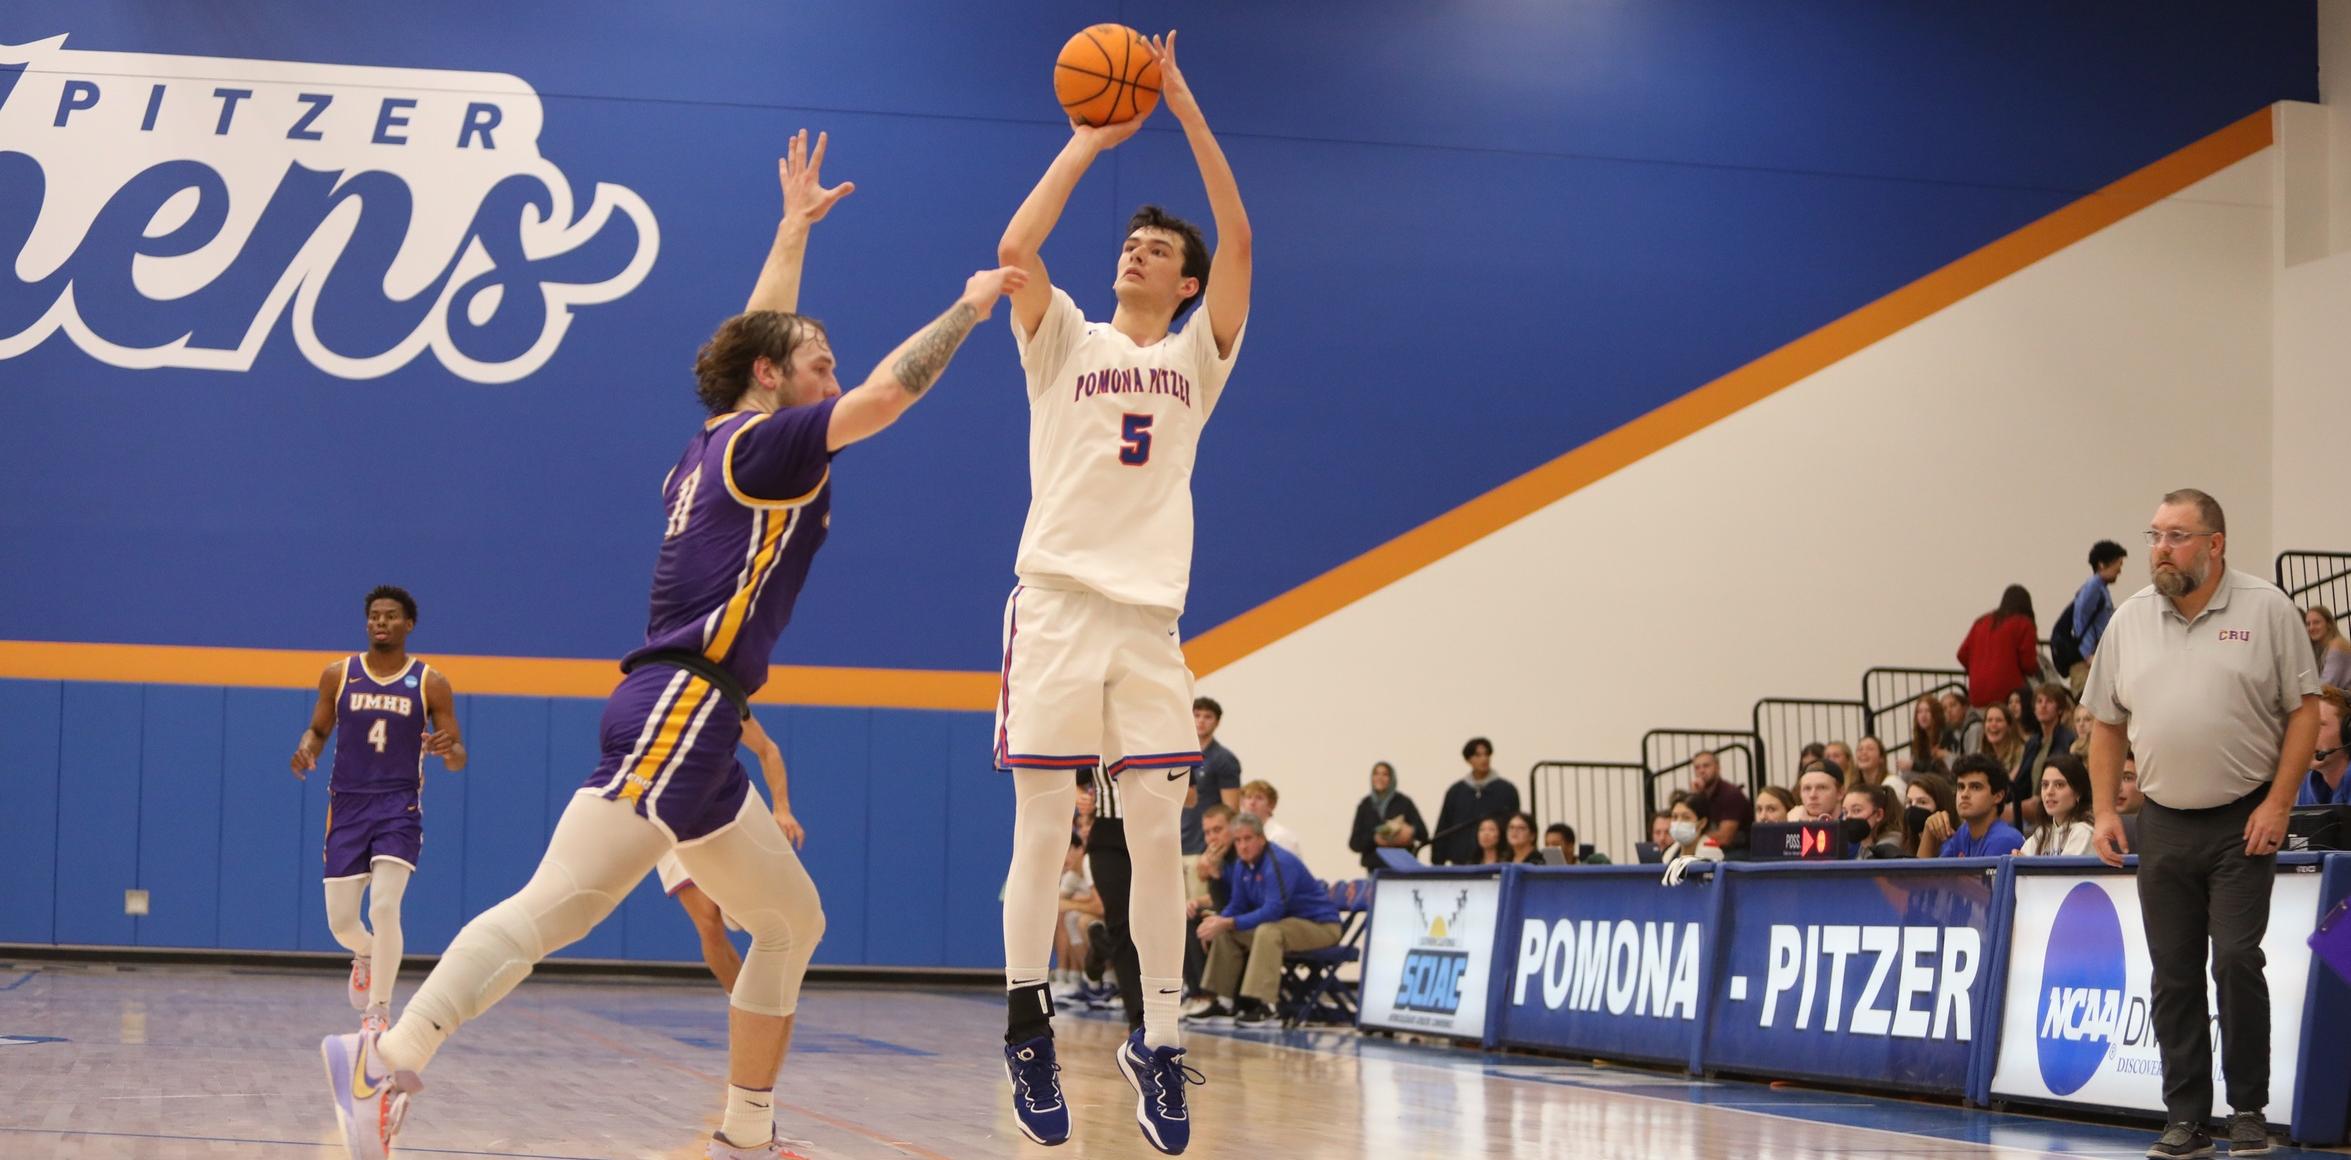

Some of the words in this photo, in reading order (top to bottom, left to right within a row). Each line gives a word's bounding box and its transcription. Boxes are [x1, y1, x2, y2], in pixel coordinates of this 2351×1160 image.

[53, 80, 503, 149] PITZER
[1074, 366, 1144, 402] POMONA
[1119, 412, 1153, 467] 5
[2218, 630, 2250, 642] CRU
[349, 692, 412, 717] UMHB
[367, 719, 387, 753] 4
[1513, 918, 1700, 1020] POMONA
[1759, 924, 1981, 1041] PITZER
[2041, 986, 2122, 1044] NCAA
